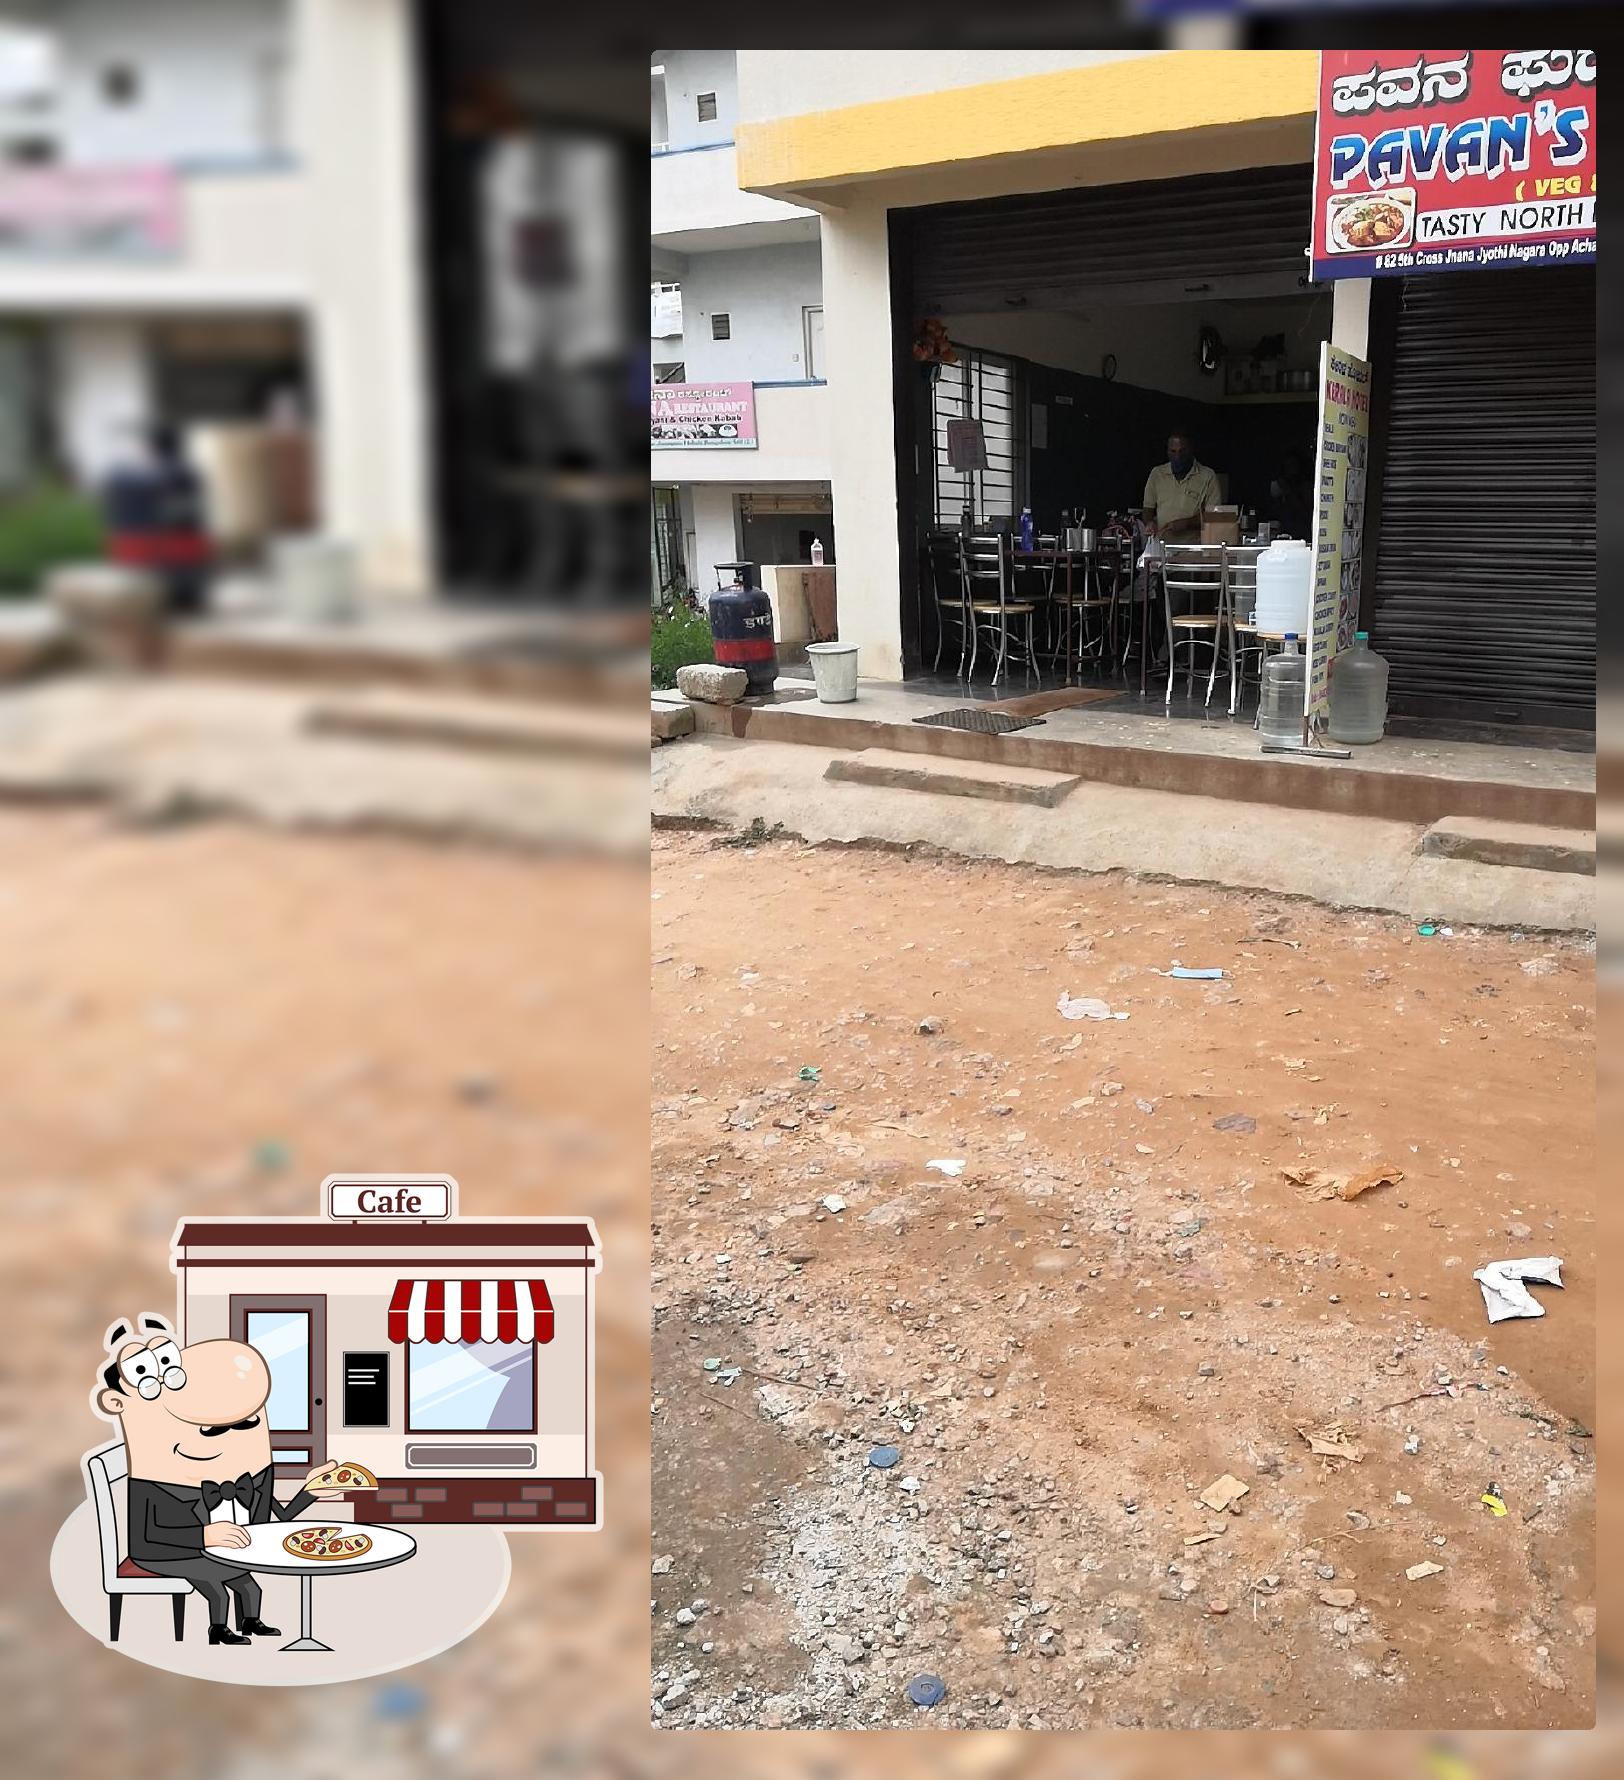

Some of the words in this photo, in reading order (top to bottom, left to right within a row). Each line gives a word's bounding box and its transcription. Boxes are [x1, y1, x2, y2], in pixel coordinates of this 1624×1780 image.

[1332, 51, 1472, 114] ಪವನ
[1330, 99, 1590, 190] PAVAN'S
[1535, 175, 1582, 197] VEG
[1421, 211, 1487, 238] TASTY
[1500, 202, 1584, 231] NORTH
[1416, 250, 1444, 265] Cross
[1445, 248, 1475, 264] Jnana
[1477, 244, 1508, 264] Jyothi
[1508, 243, 1546, 262] Nagara
[1549, 240, 1570, 258] Opp
[674, 402, 748, 414] RESTAURANT
[679, 414, 713, 424] Chicken
